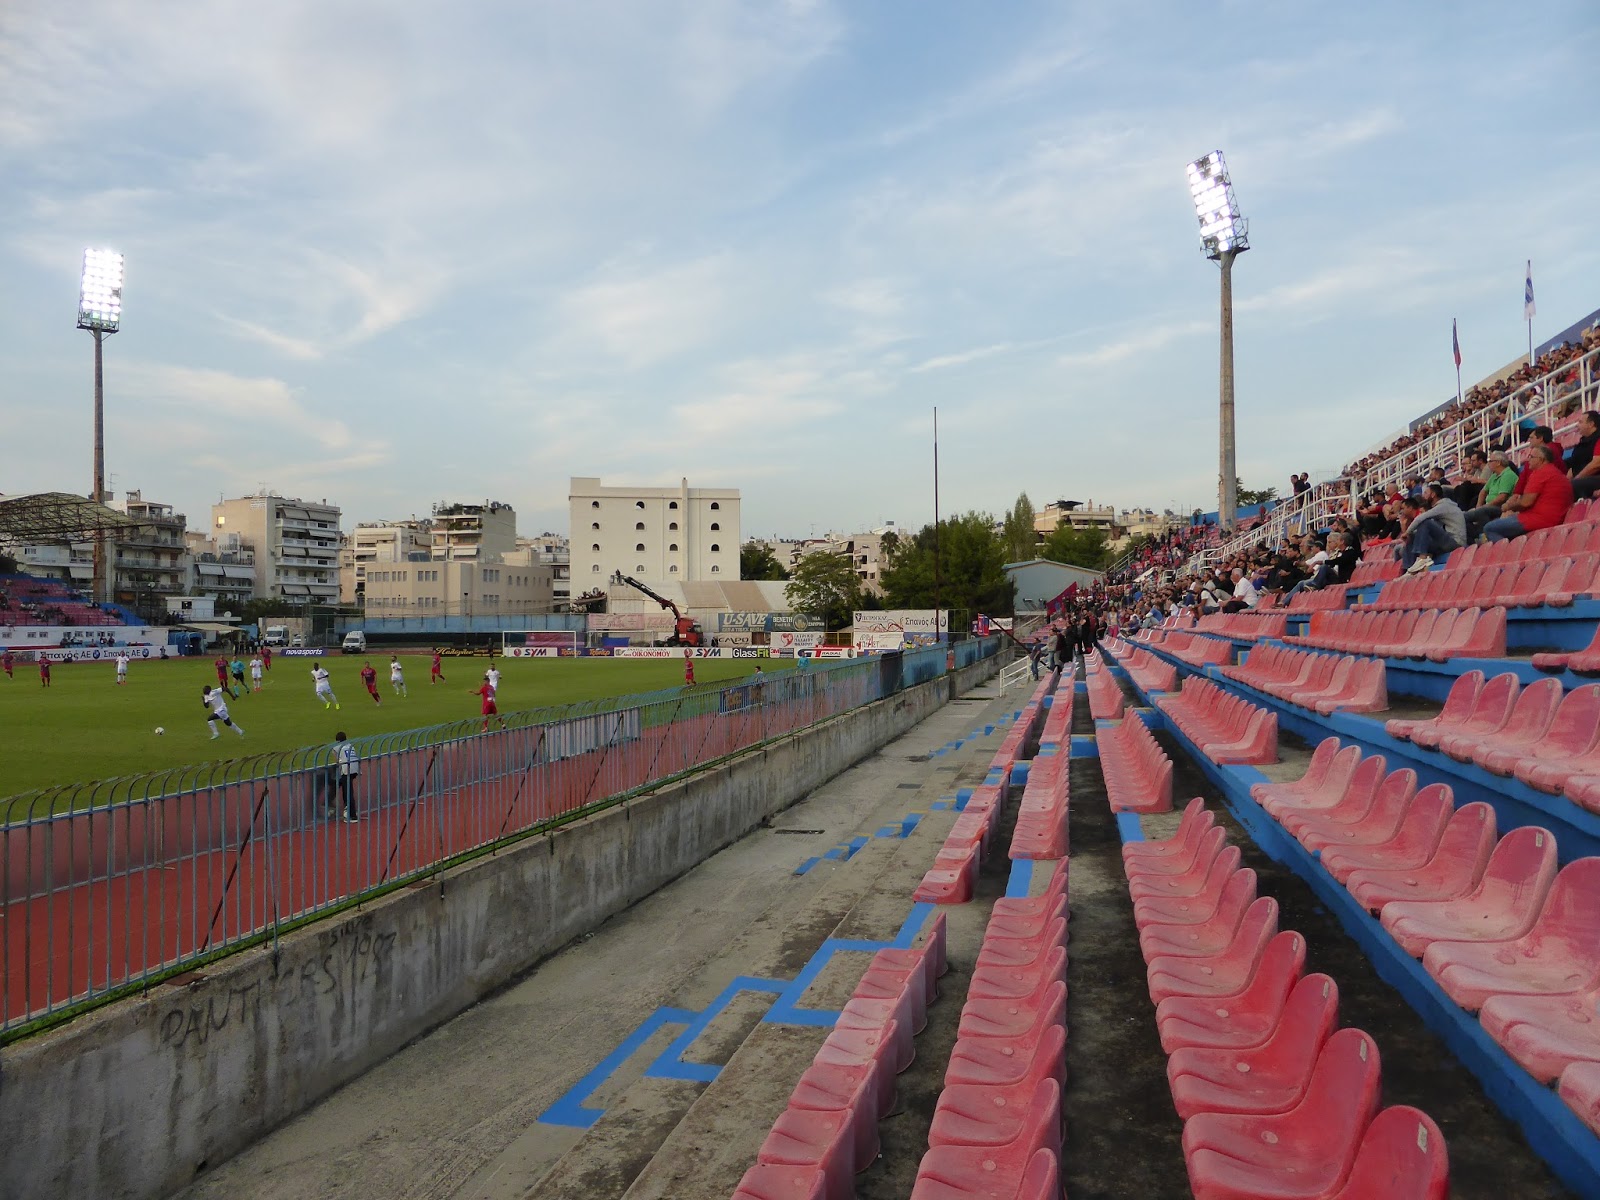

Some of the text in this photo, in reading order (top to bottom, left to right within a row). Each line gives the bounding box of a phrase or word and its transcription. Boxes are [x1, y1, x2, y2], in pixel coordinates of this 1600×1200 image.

[722, 613, 768, 627] U-SAVE
[905, 616, 929, 626] Σπανός
[103, 650, 130, 659] Σπανς
[524, 648, 547, 657] SYM
[695, 648, 721, 657] SYM
